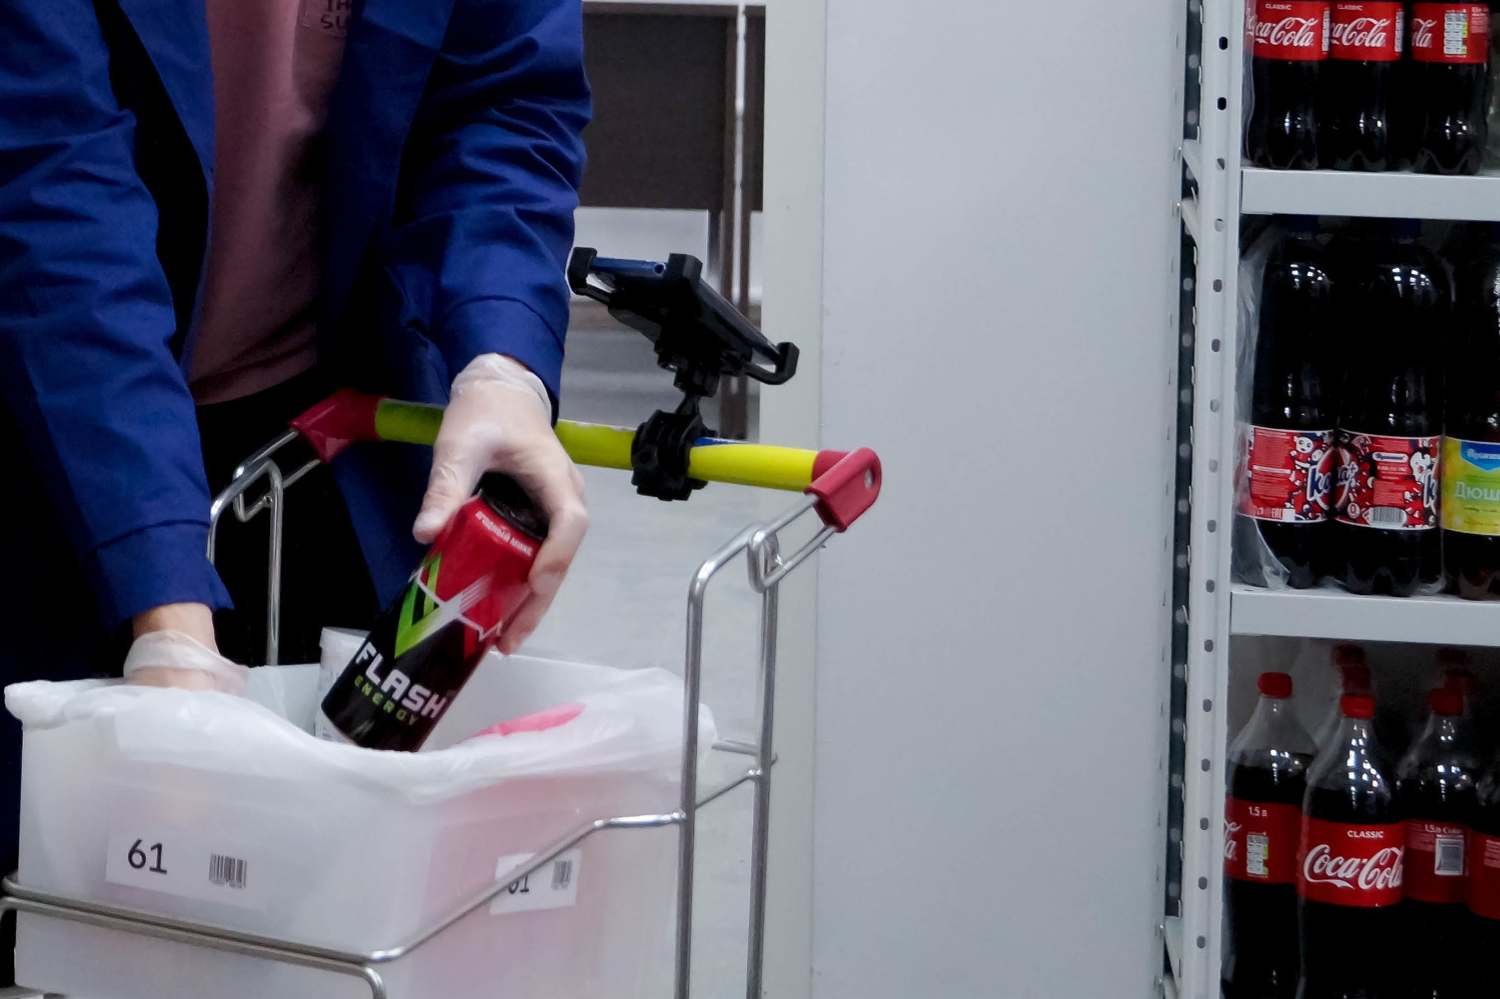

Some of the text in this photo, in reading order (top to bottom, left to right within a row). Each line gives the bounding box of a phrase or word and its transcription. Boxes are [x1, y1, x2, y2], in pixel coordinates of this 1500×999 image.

[321, 14, 348, 30] SU
[1255, 17, 1319, 47] ca-Cola
[1331, 17, 1391, 48] a-Cola
[1454, 481, 1500, 501] Дюш
[355, 641, 448, 719] FLASH
[354, 674, 419, 726] ENERGY
[1347, 829, 1384, 839] CLASSIC
[126, 838, 168, 876] 61
